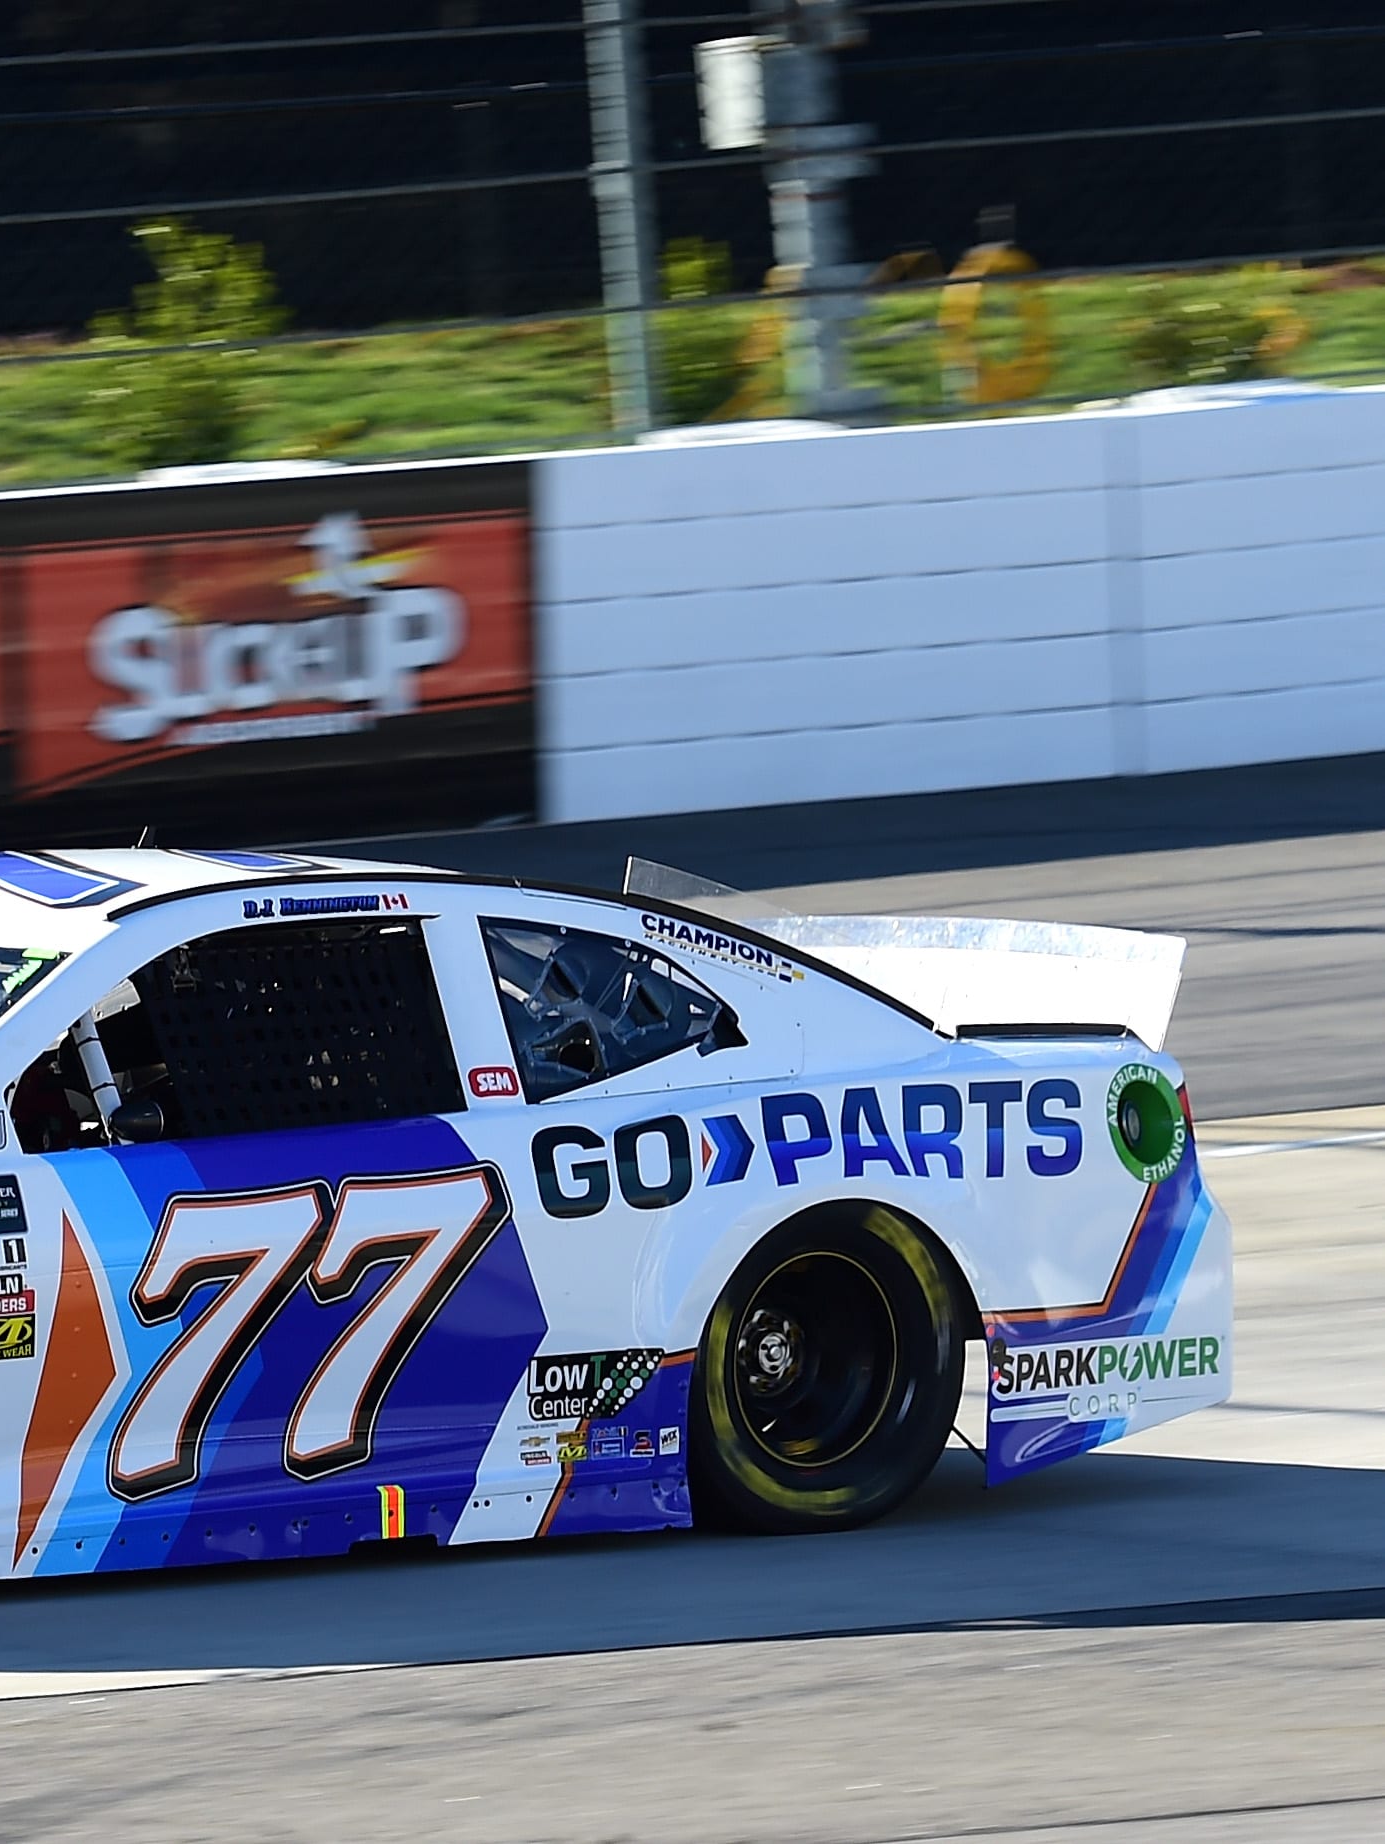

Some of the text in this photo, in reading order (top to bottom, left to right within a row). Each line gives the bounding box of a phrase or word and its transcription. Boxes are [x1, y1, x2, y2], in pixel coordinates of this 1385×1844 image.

[641, 914, 773, 967] CHAMPION
[476, 1072, 512, 1091] SEM
[1107, 1065, 1158, 1127] AMERICAN
[532, 1078, 1082, 1218] GO PARTS
[1142, 1115, 1185, 1181] ETHANOL
[3, 1239, 26, 1264] 1
[108, 1162, 511, 1502] 77
[2, 1345, 32, 1358] WEAR
[590, 1355, 607, 1388] T
[530, 1396, 590, 1419] Center
[1069, 1392, 1138, 1417] CORP
